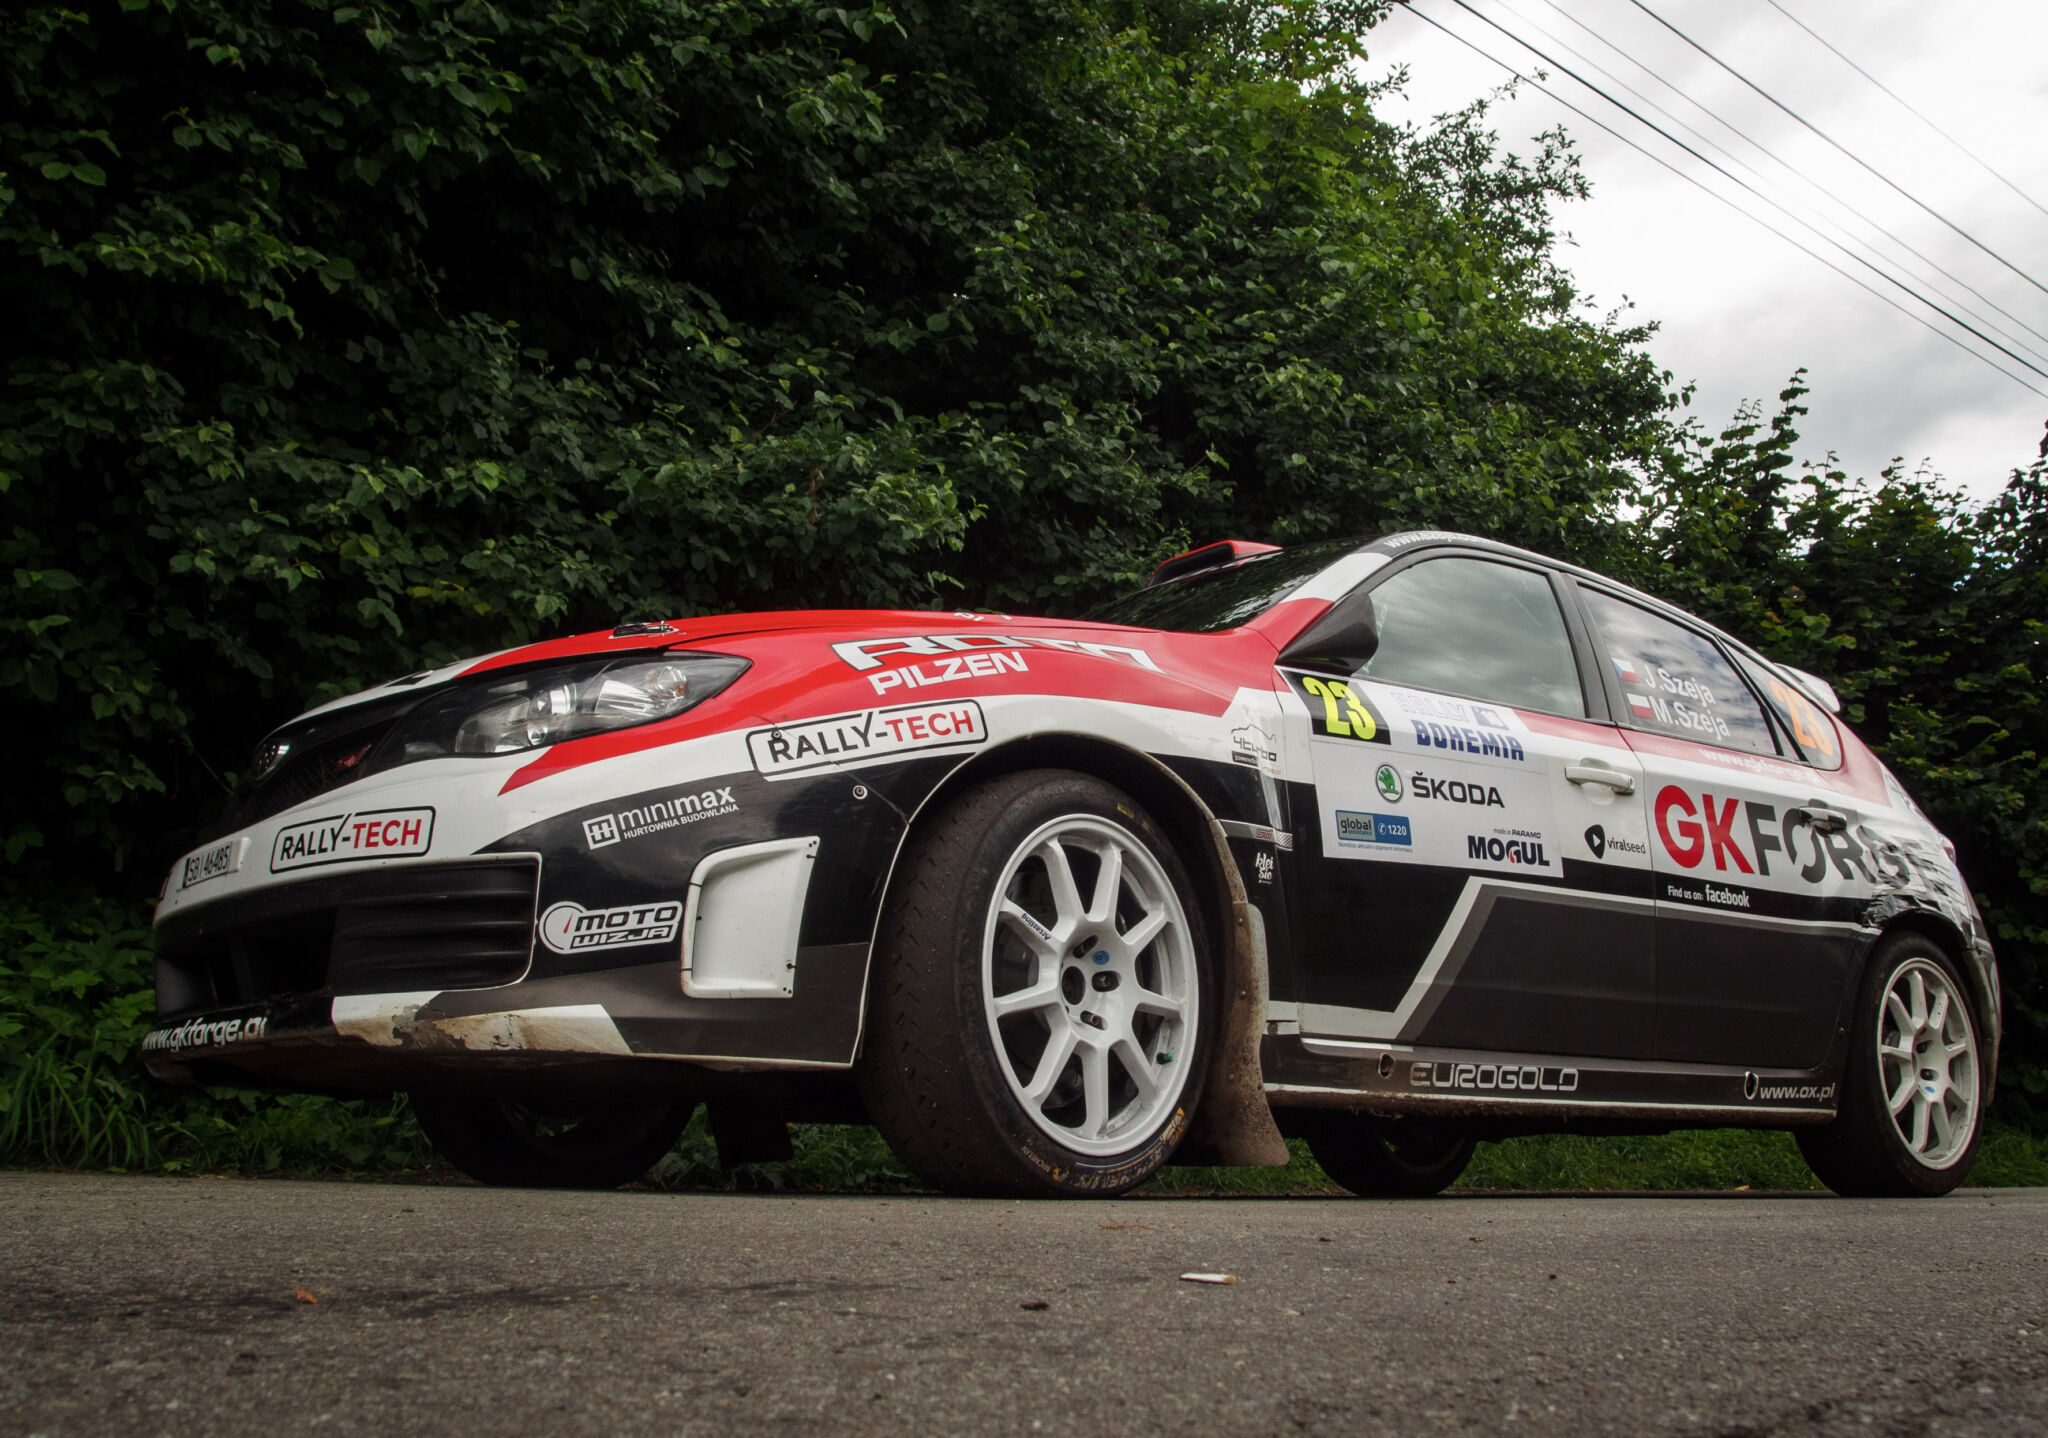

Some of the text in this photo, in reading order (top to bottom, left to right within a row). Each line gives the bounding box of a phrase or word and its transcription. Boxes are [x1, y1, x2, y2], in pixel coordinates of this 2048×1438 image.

[867, 650, 1029, 695] PILZEN
[1643, 664, 1716, 707] J.Szeja
[1302, 676, 1376, 740] 23
[1648, 695, 1731, 740] M.Szeja
[1769, 680, 1834, 756] 23
[767, 710, 975, 764] RALLY-TECH
[1410, 719, 1525, 761] BOHEMIA
[1411, 770, 1505, 808] ŠKODA
[617, 786, 736, 830] minimax
[623, 804, 740, 840] HURTOWNIA BUDOWLANA
[1340, 818, 1372, 834] global
[279, 813, 422, 861] RALLY-TECH
[1387, 824, 1407, 836] 1220
[1511, 829, 1541, 839] PARAMO
[1606, 837, 1646, 854] viralseed
[1467, 834, 1550, 867] MOGUL
[1667, 884, 1750, 908] Find us on: facebook
[575, 905, 679, 932] MOTO
[572, 926, 671, 948] WIZJA
[1410, 1062, 1579, 1092] EUROGOLD
[1759, 1082, 1836, 1102] www.ox.pl
